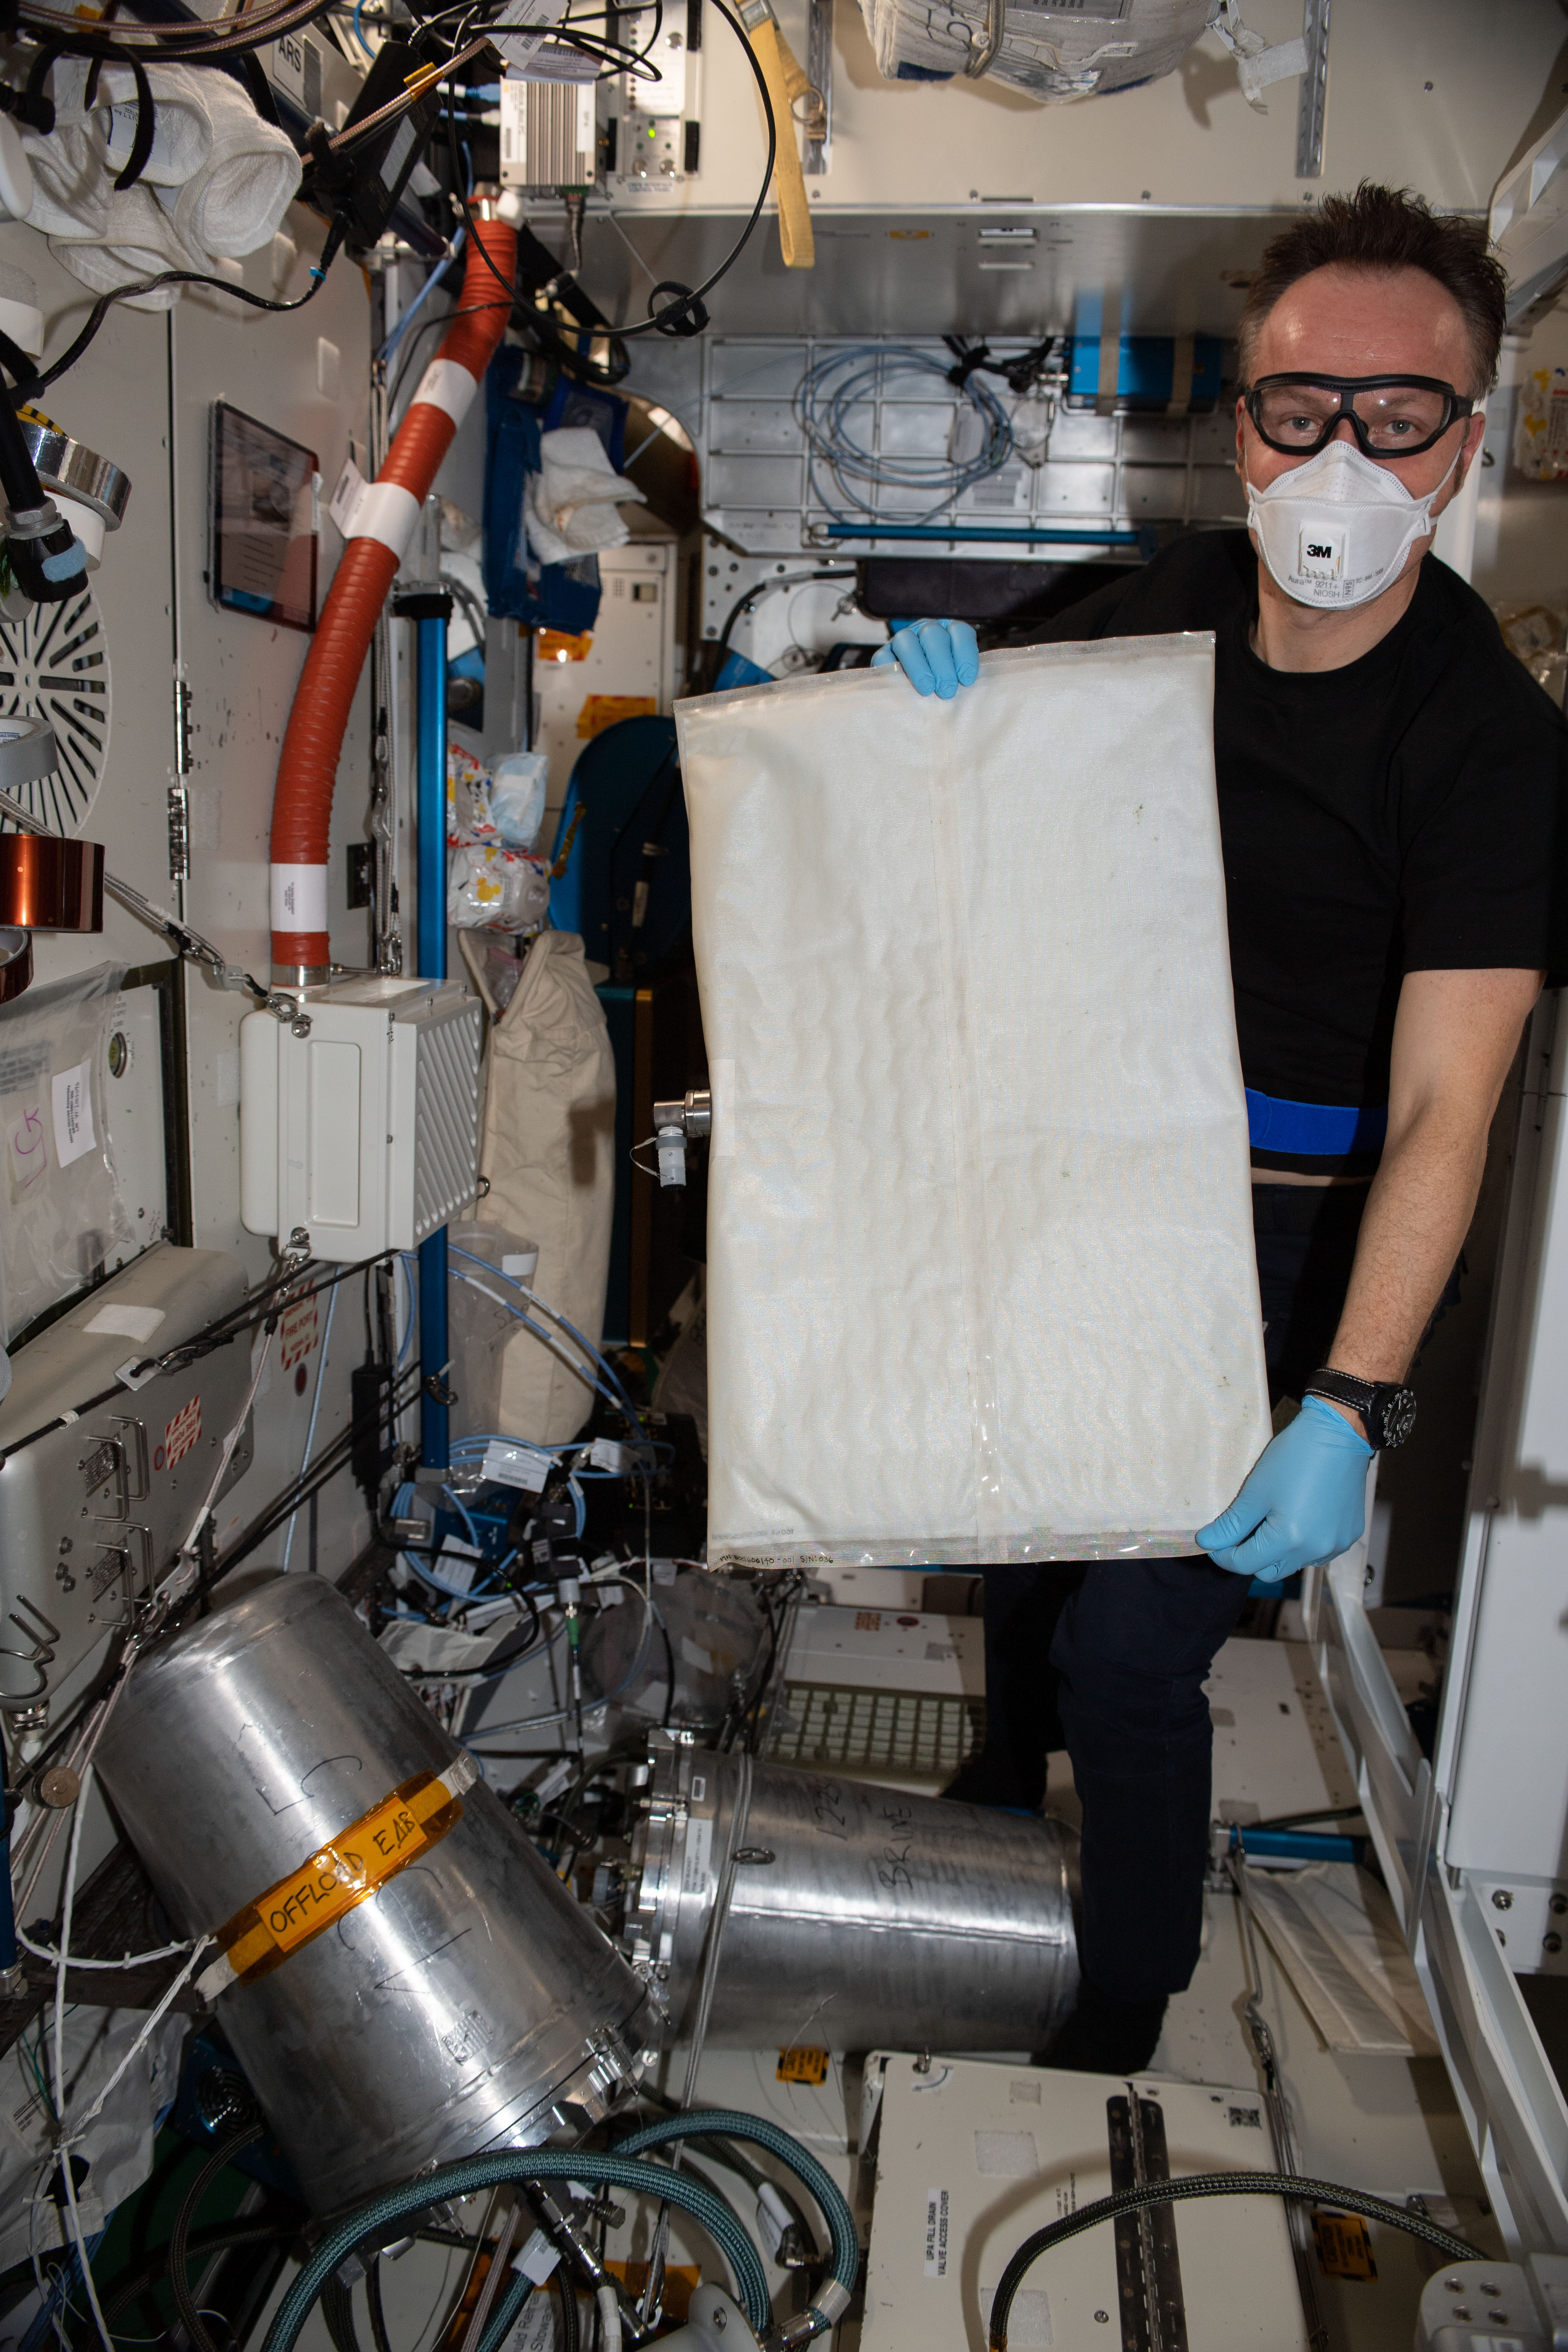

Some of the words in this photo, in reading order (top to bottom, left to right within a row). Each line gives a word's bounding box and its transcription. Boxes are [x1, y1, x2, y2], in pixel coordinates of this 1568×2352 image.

[279, 38, 301, 73] ARS
[1307, 544, 1332, 558] 3M
[1314, 589, 1339, 598] NIOSH
[1315, 580, 1339, 589] 9211+
[286, 1322, 297, 1338] FIRE
[299, 1310, 313, 1328] PORT
[270, 1852, 364, 1933] OFFLOAD
[928, 2201, 936, 2225] DRAIN
[940, 2190, 949, 2216] COVER
[927, 2227, 935, 2243] FILL
[939, 2217, 948, 2249] ACCESS
[926, 2244, 934, 2260] UPA
[938, 2250, 946, 2276] VALVE
